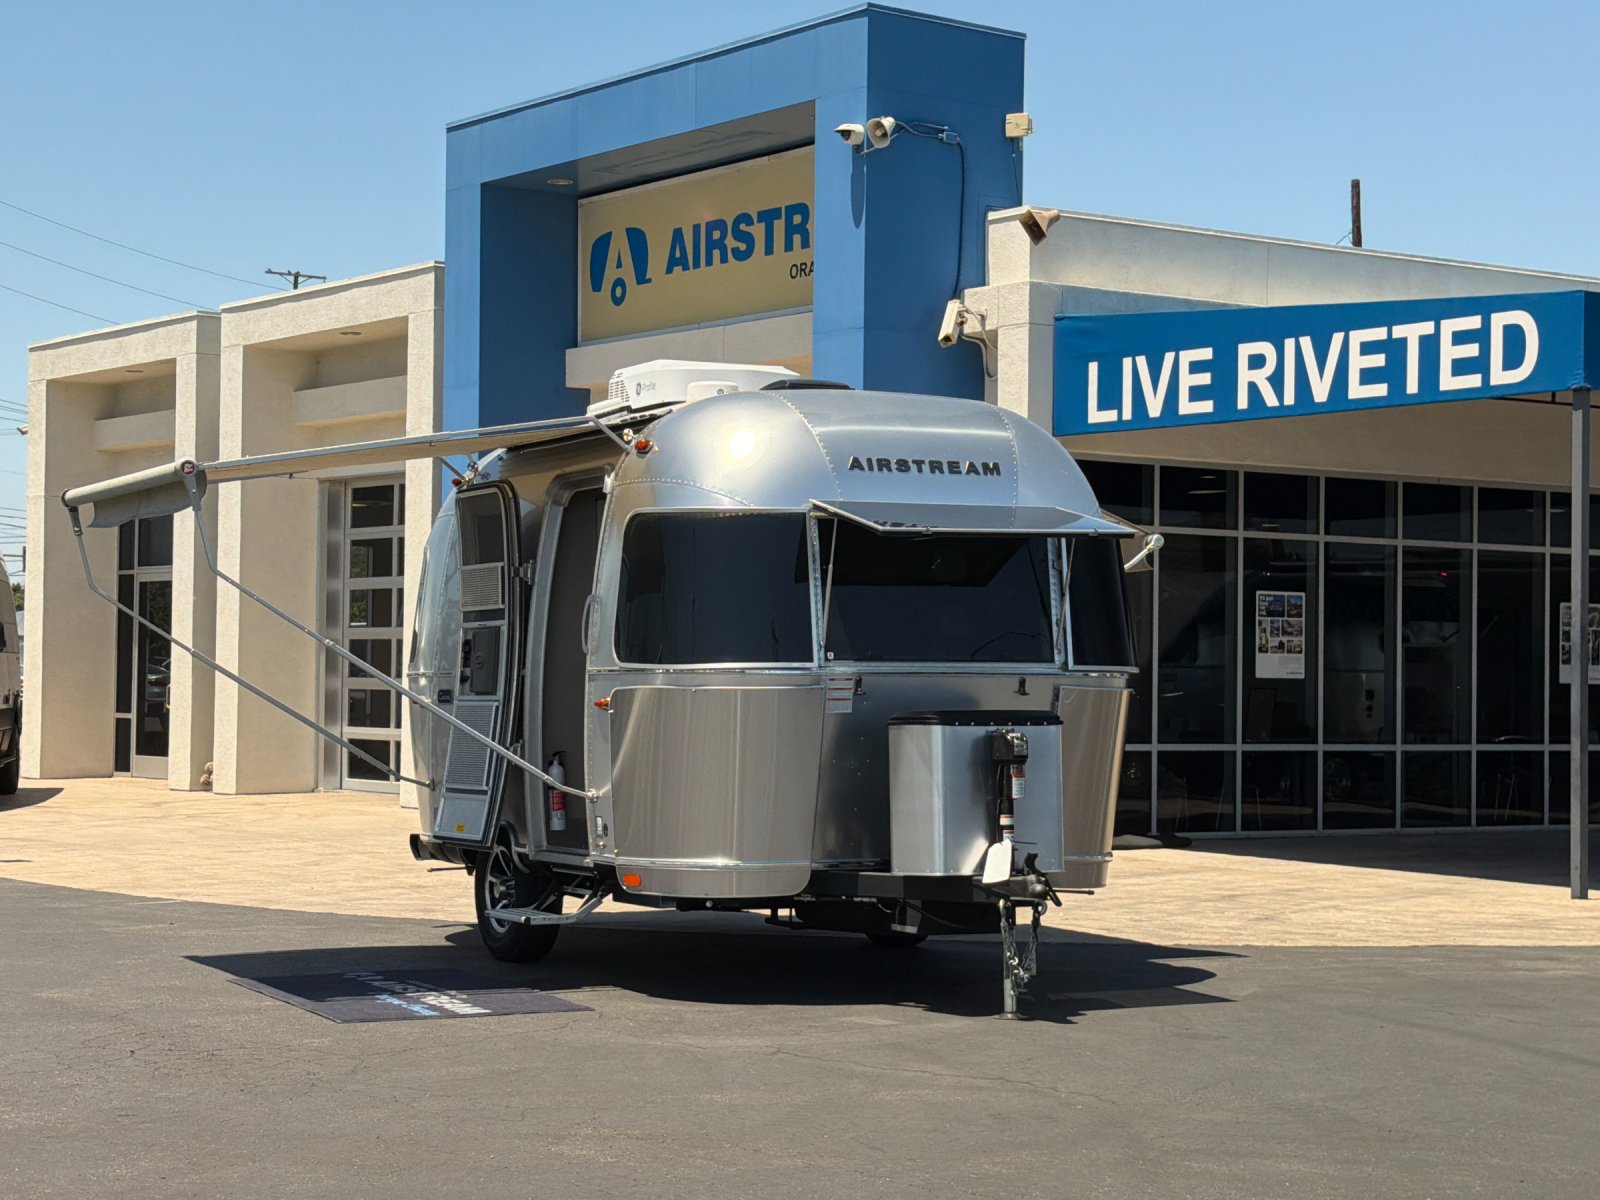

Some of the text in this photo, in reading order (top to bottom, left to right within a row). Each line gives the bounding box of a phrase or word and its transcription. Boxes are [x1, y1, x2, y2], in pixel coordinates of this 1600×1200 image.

[1087, 309, 1540, 424] LIVE RIVETED
[848, 455, 1002, 476] AIRSTREAM
